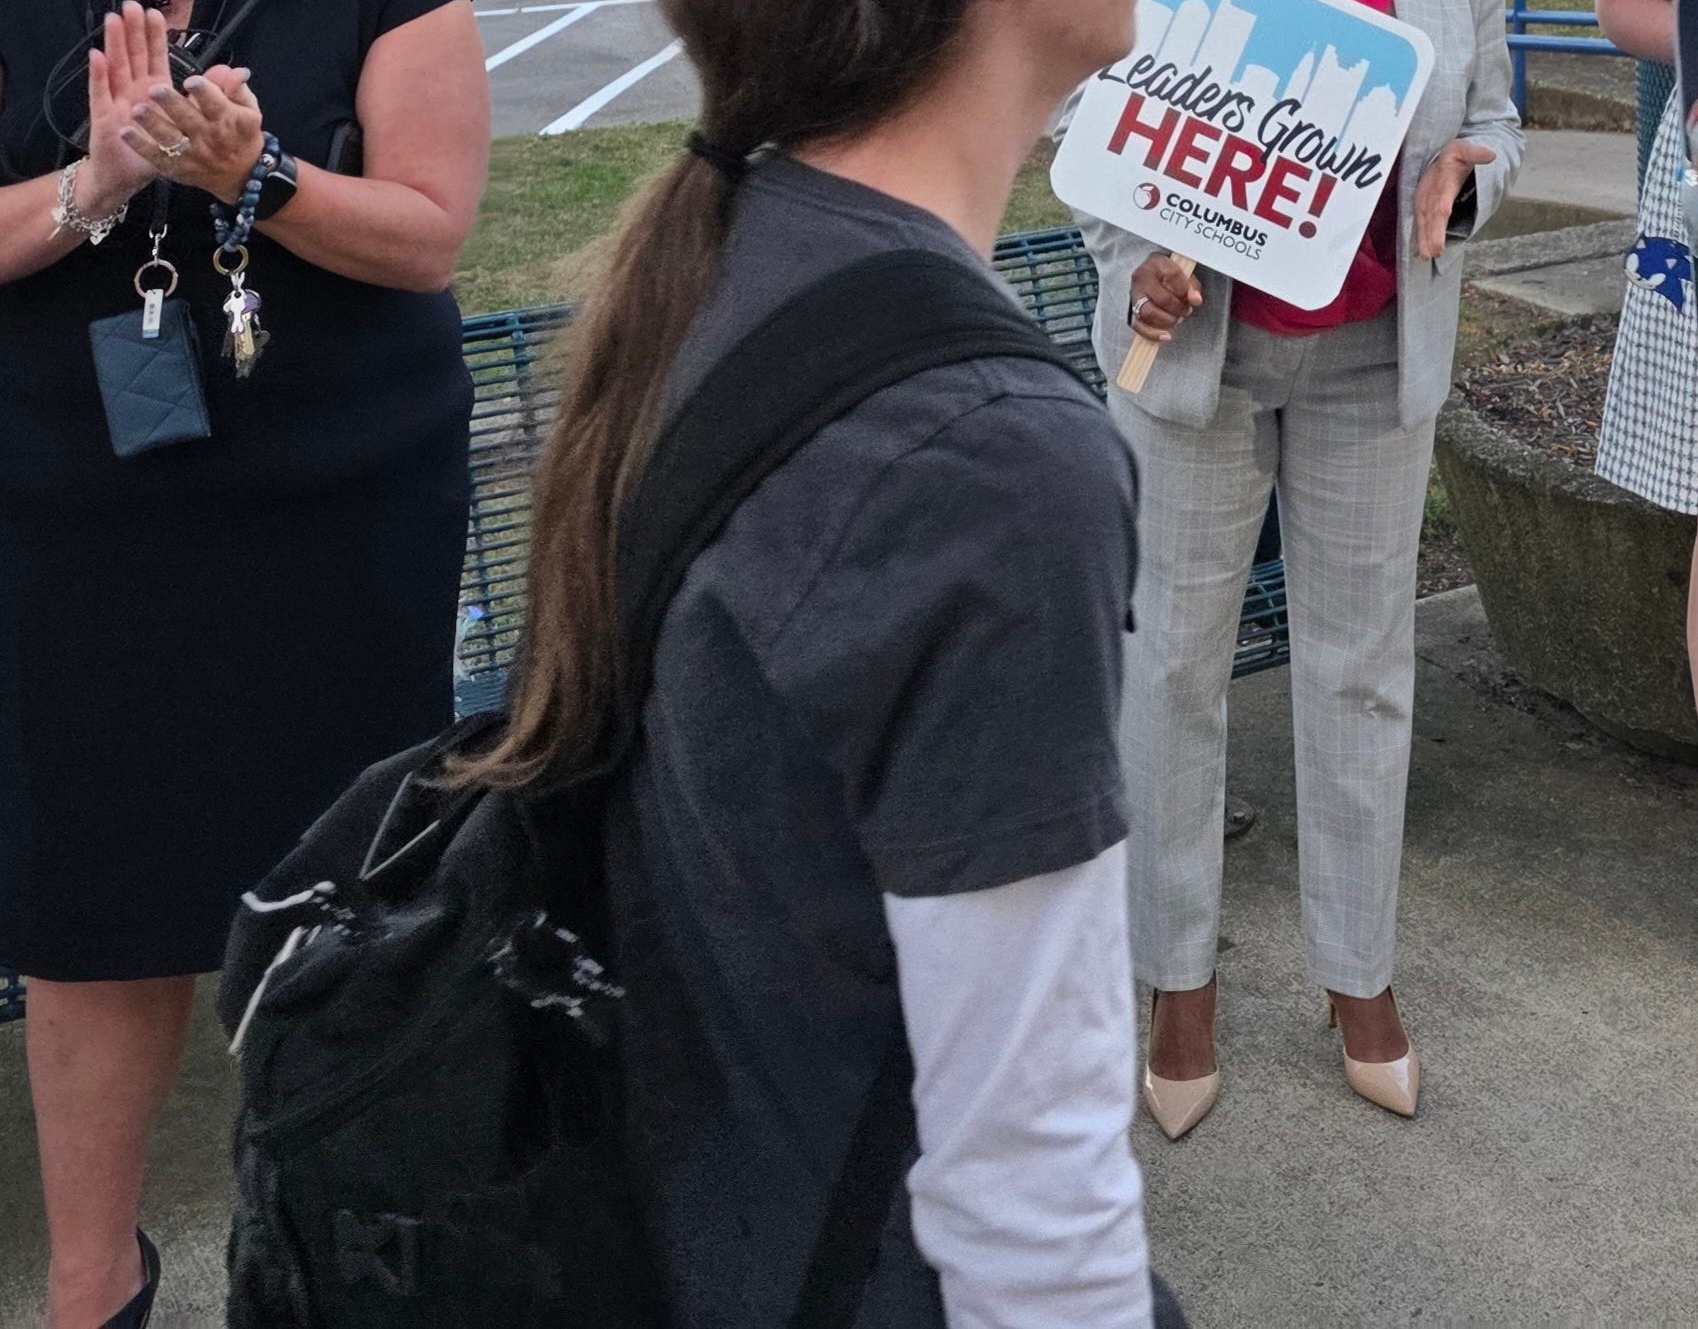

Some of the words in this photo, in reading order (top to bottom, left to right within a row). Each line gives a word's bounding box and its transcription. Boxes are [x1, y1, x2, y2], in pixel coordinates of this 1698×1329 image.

[1106, 90, 1339, 240] HERE!
[1257, 97, 1384, 190] Grown
[1159, 208, 1196, 232] CITY
[1193, 221, 1264, 262] SCHOOLS
[1166, 192, 1269, 247] COLUMBUS
